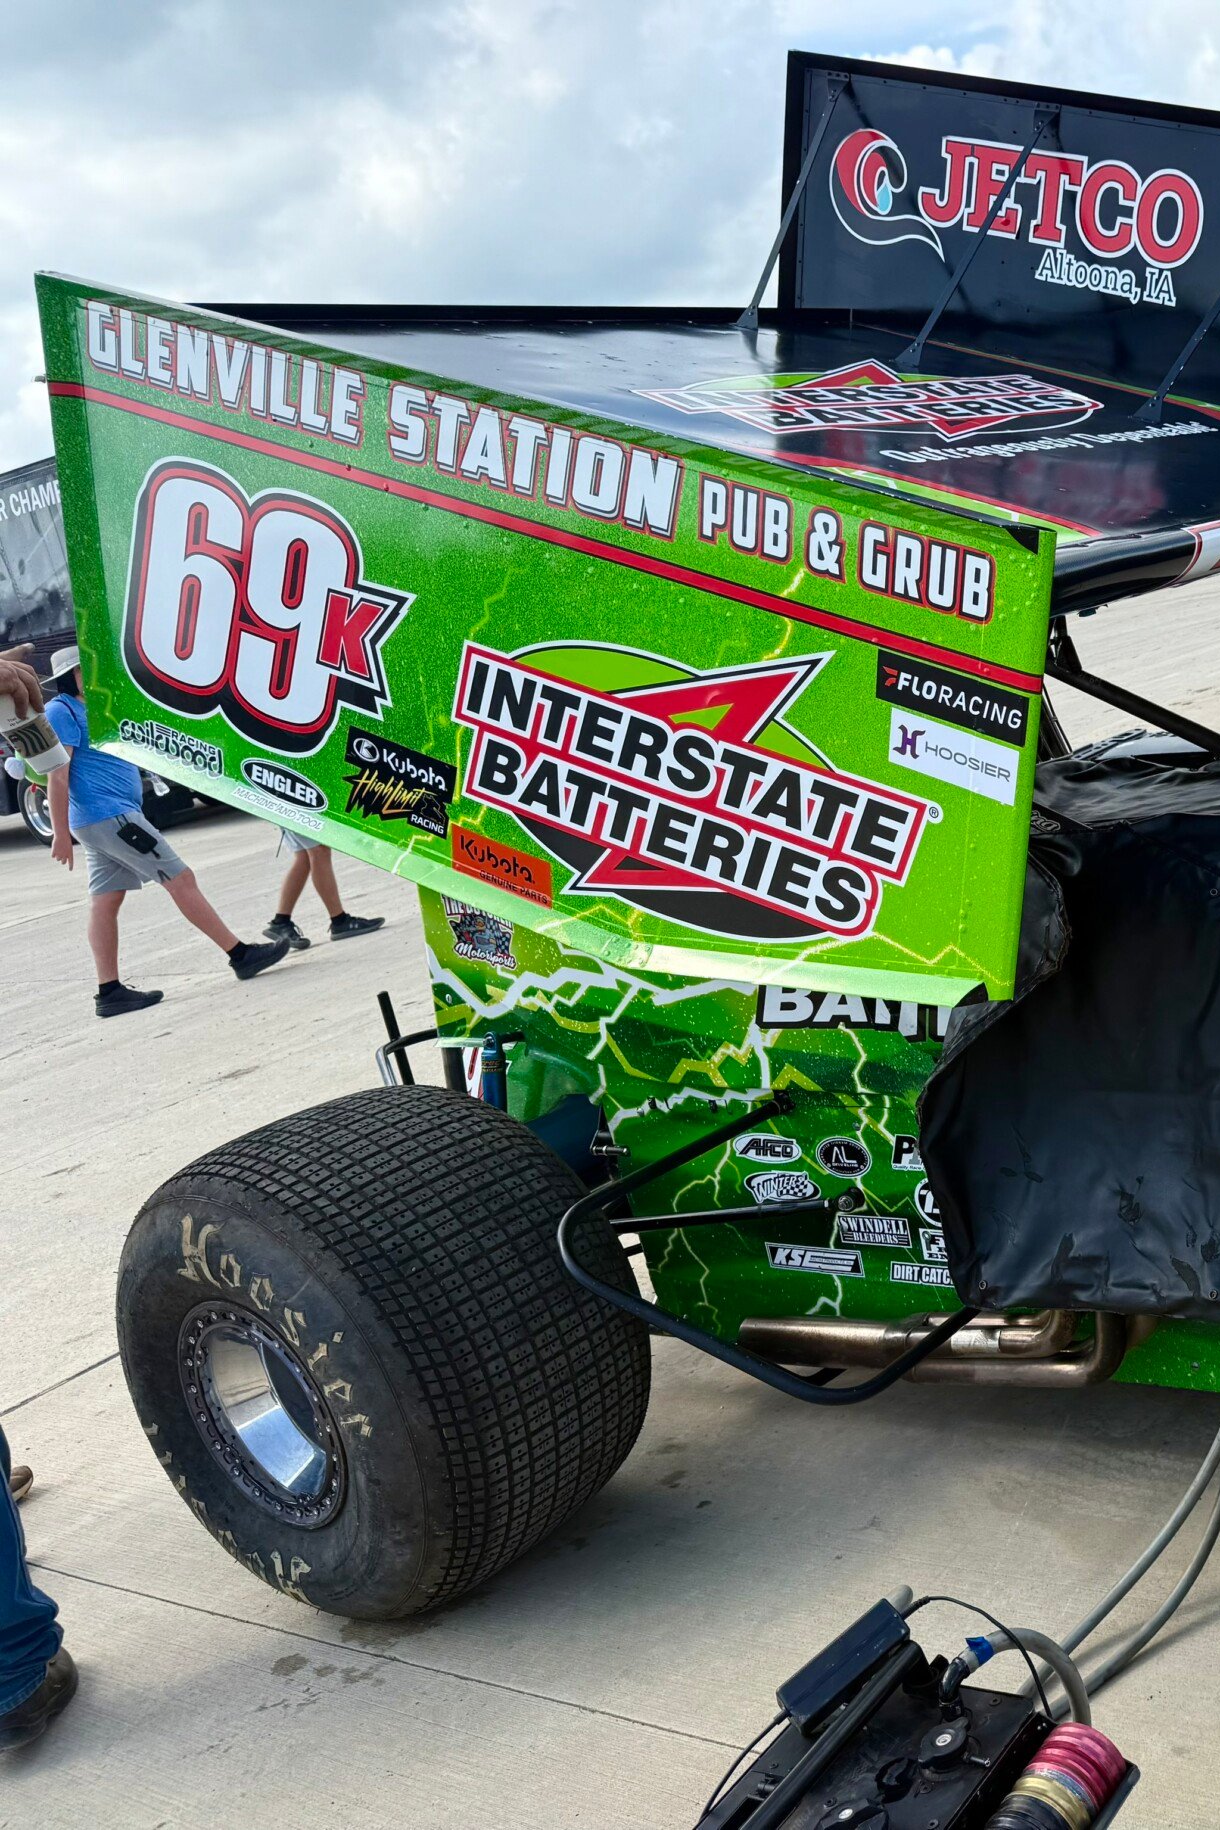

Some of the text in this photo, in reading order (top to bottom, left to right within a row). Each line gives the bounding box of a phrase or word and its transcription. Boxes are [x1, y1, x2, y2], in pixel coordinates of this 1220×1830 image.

[918, 136, 1203, 268] JETCO
[1035, 248, 1177, 307] Altoona, IA
[87, 298, 996, 625] GLENVILLE STATION PUB & GRUB
[898, 671, 1023, 730] FLORACING
[171, 731, 216, 756] RACING
[465, 659, 911, 869] INTERSTATE
[924, 740, 1012, 783] HOOSIER
[250, 763, 318, 807] ENGLER
[383, 748, 448, 792] Kubota
[234, 787, 323, 831] MACHINE AND TOOL
[410, 813, 445, 836] RACING
[478, 738, 871, 928] BATTERIES
[460, 834, 536, 885] Kubota
[479, 869, 548, 905] GENUINE PARTS
[454, 942, 516, 969] Motorsports
[738, 1137, 795, 1160] AFCO
[753, 1174, 804, 1199] WINTERS
[839, 1215, 908, 1236] SWINDELL
[852, 1231, 899, 1245] BLEEDERS
[773, 1247, 857, 1272] KSE
[893, 1264, 953, 1285] DIRT CATC
